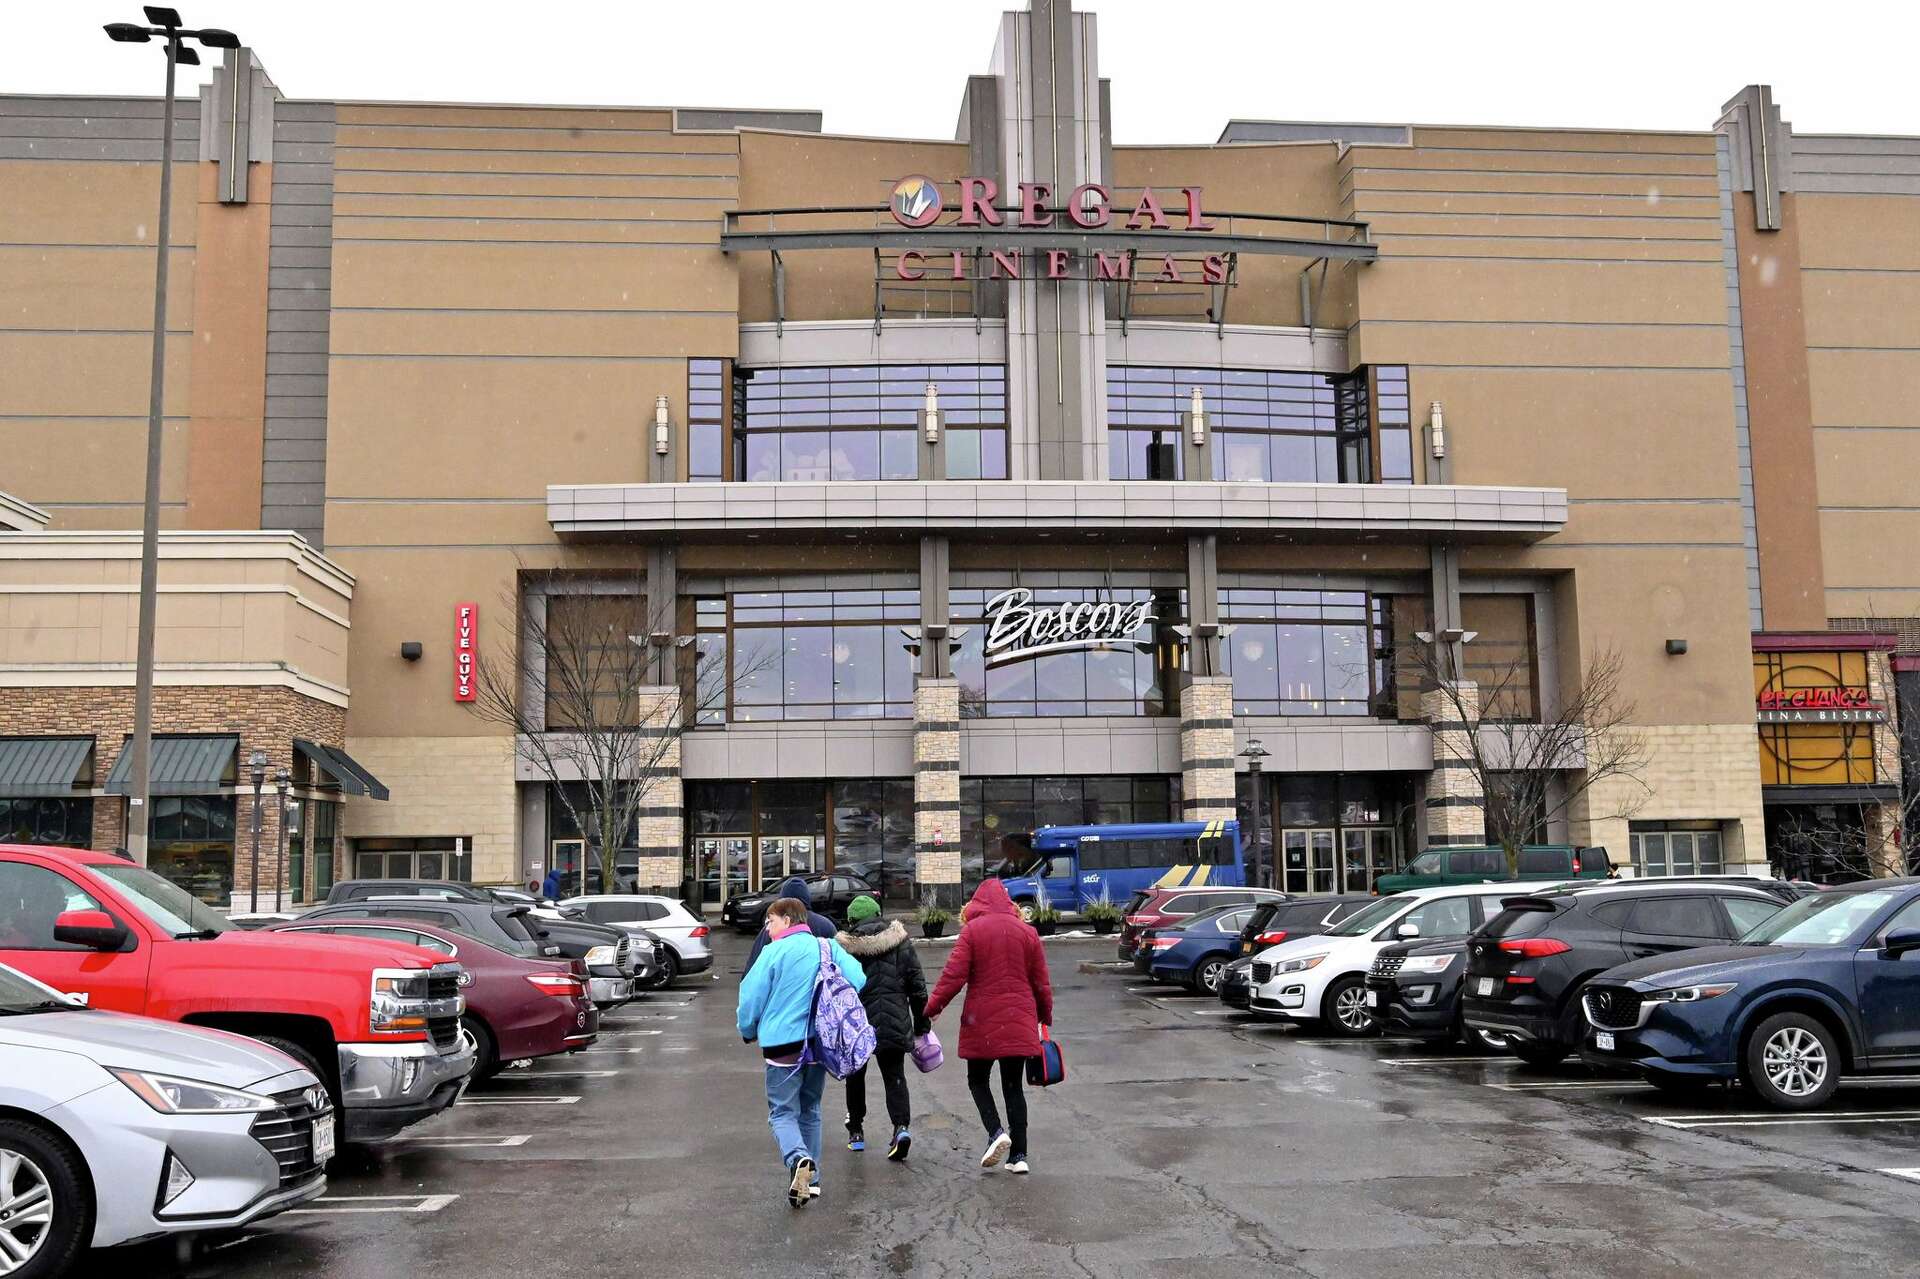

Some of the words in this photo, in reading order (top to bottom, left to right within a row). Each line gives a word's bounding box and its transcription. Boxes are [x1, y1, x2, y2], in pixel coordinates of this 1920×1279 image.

[956, 176, 1216, 232] REGAL
[896, 250, 1227, 284] CINEMAS
[460, 607, 470, 648] FIVE
[459, 653, 471, 696] GUYS
